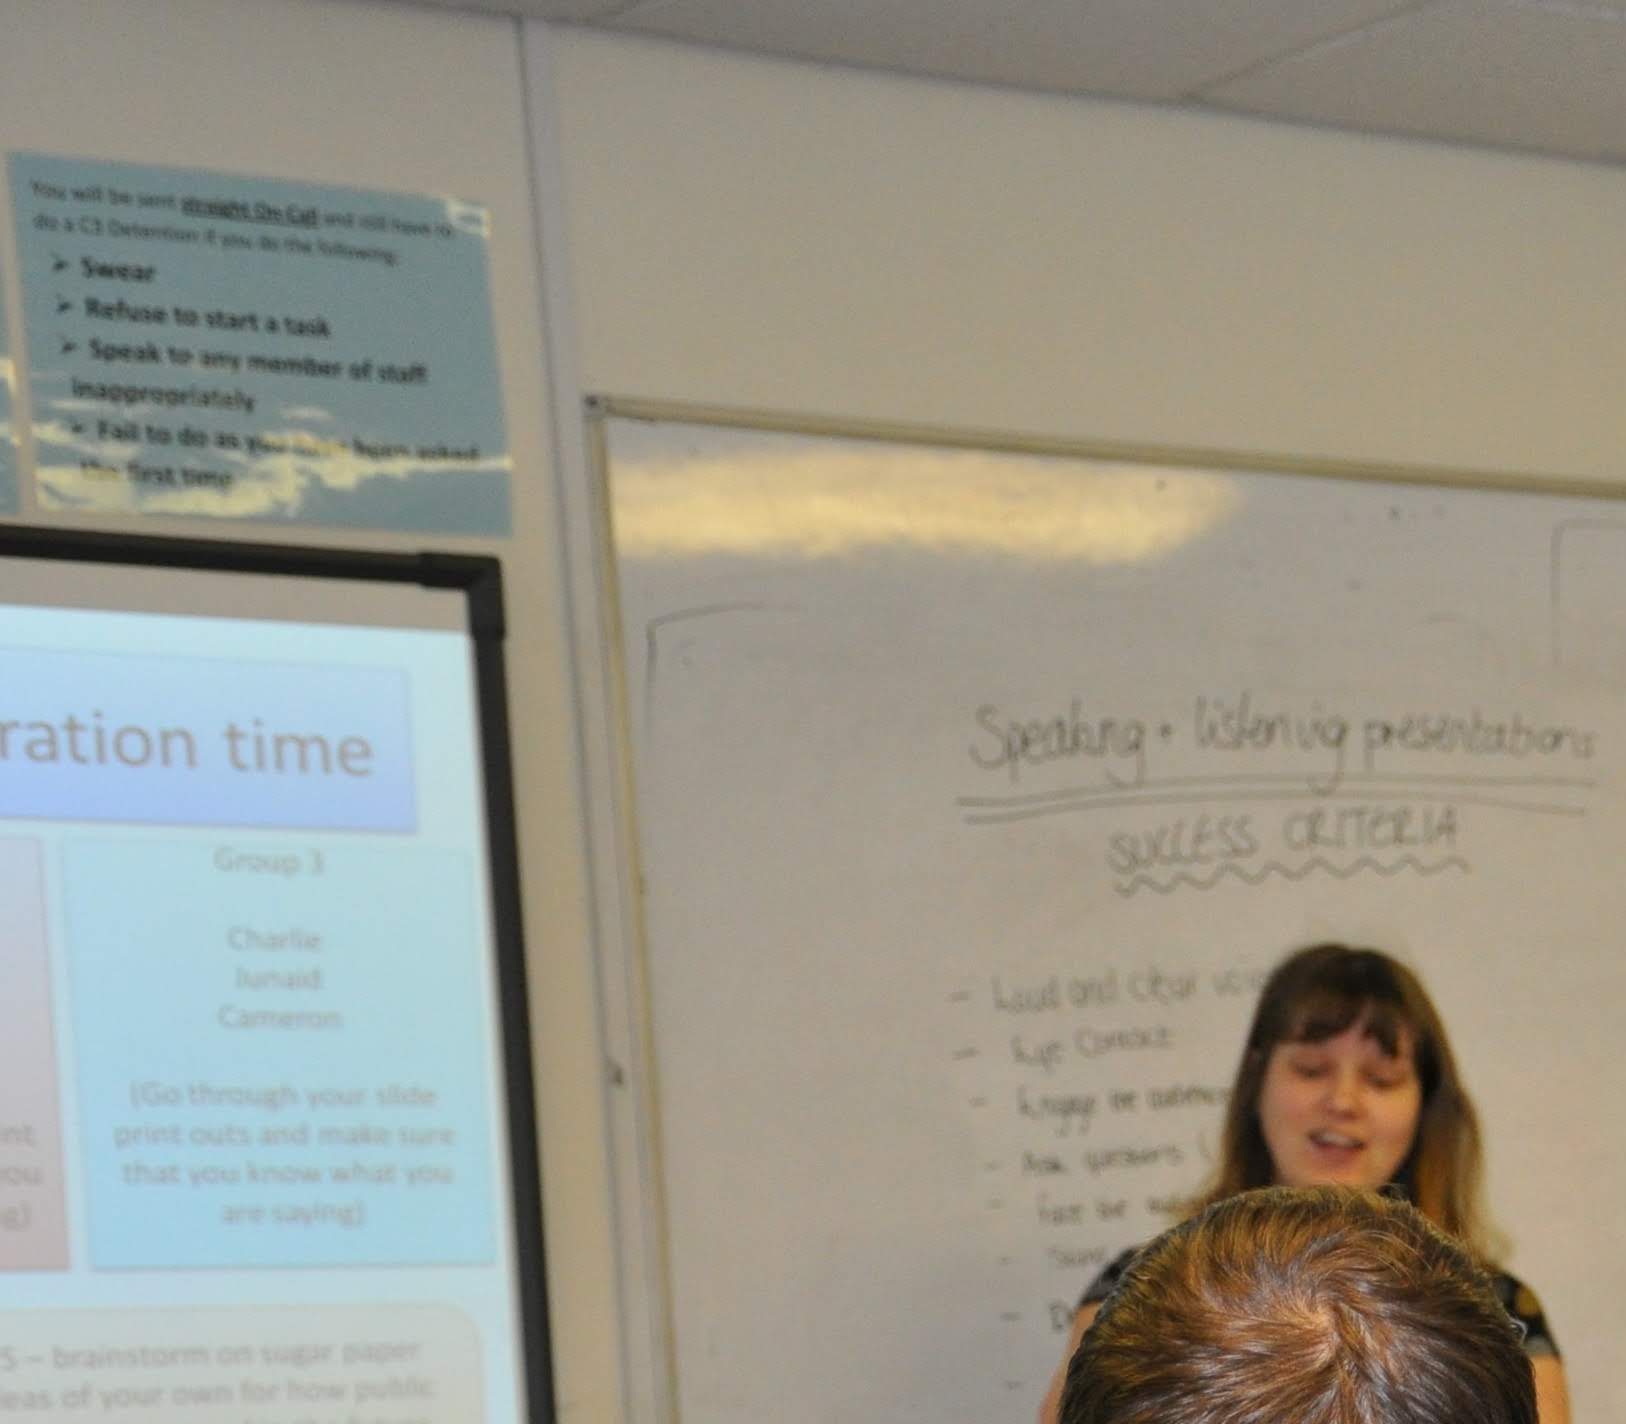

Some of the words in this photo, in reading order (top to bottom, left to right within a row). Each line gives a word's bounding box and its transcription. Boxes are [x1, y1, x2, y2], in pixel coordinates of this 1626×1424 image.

[106, 217, 199, 243] Detention
[80, 255, 157, 284] Swear
[84, 297, 169, 326] Refuse
[172, 306, 199, 328] to
[203, 310, 259, 334] start
[264, 317, 280, 335] a
[283, 314, 332, 339] task
[88, 336, 161, 365] Speak
[166, 346, 194, 367] to
[200, 351, 242, 375] any
[245, 350, 344, 378] member
[347, 356, 375, 383] of
[376, 361, 431, 388] staff
[97, 417, 140, 443] Fail
[144, 422, 173, 446] to
[176, 423, 209, 449] do
[212, 431, 242, 451] as
[125, 459, 179, 489] first
[179, 465, 235, 489] time
[225, 718, 375, 779] time
[1360, 700, 1597, 778] presentations
[1282, 804, 1458, 852] CRITERIA
[212, 845, 303, 879] Group
[224, 924, 325, 955] Charlie
[234, 963, 326, 993] Junaid
[1065, 966, 1119, 1008] and
[216, 1002, 345, 1032] Cameron
[187, 1081, 300, 1112] through
[303, 1086, 367, 1112] your
[375, 1081, 440, 1110] slide
[112, 1121, 184, 1151] print
[188, 1124, 251, 1148] outs
[257, 1121, 310, 1149] and
[316, 1121, 393, 1148] make
[396, 1125, 457, 1149] sure
[120, 1160, 183, 1187] that
[187, 1165, 241, 1190] you
[246, 1160, 324, 1187] know
[328, 1160, 398, 1187] what
[405, 1164, 458, 1190] you
[218, 1203, 264, 1227] are
[269, 1200, 367, 1230] saying)
[52, 1343, 210, 1371] brainstorm
[215, 1345, 256, 1369] on
[260, 1342, 334, 1372] sugar
[341, 1340, 423, 1370] paper
[60, 1381, 92, 1410] of
[98, 1386, 164, 1413] your
[172, 1384, 236, 1407] own
[239, 1378, 280, 1405] for
[285, 1377, 348, 1403] how
[353, 1374, 434, 1405] public
